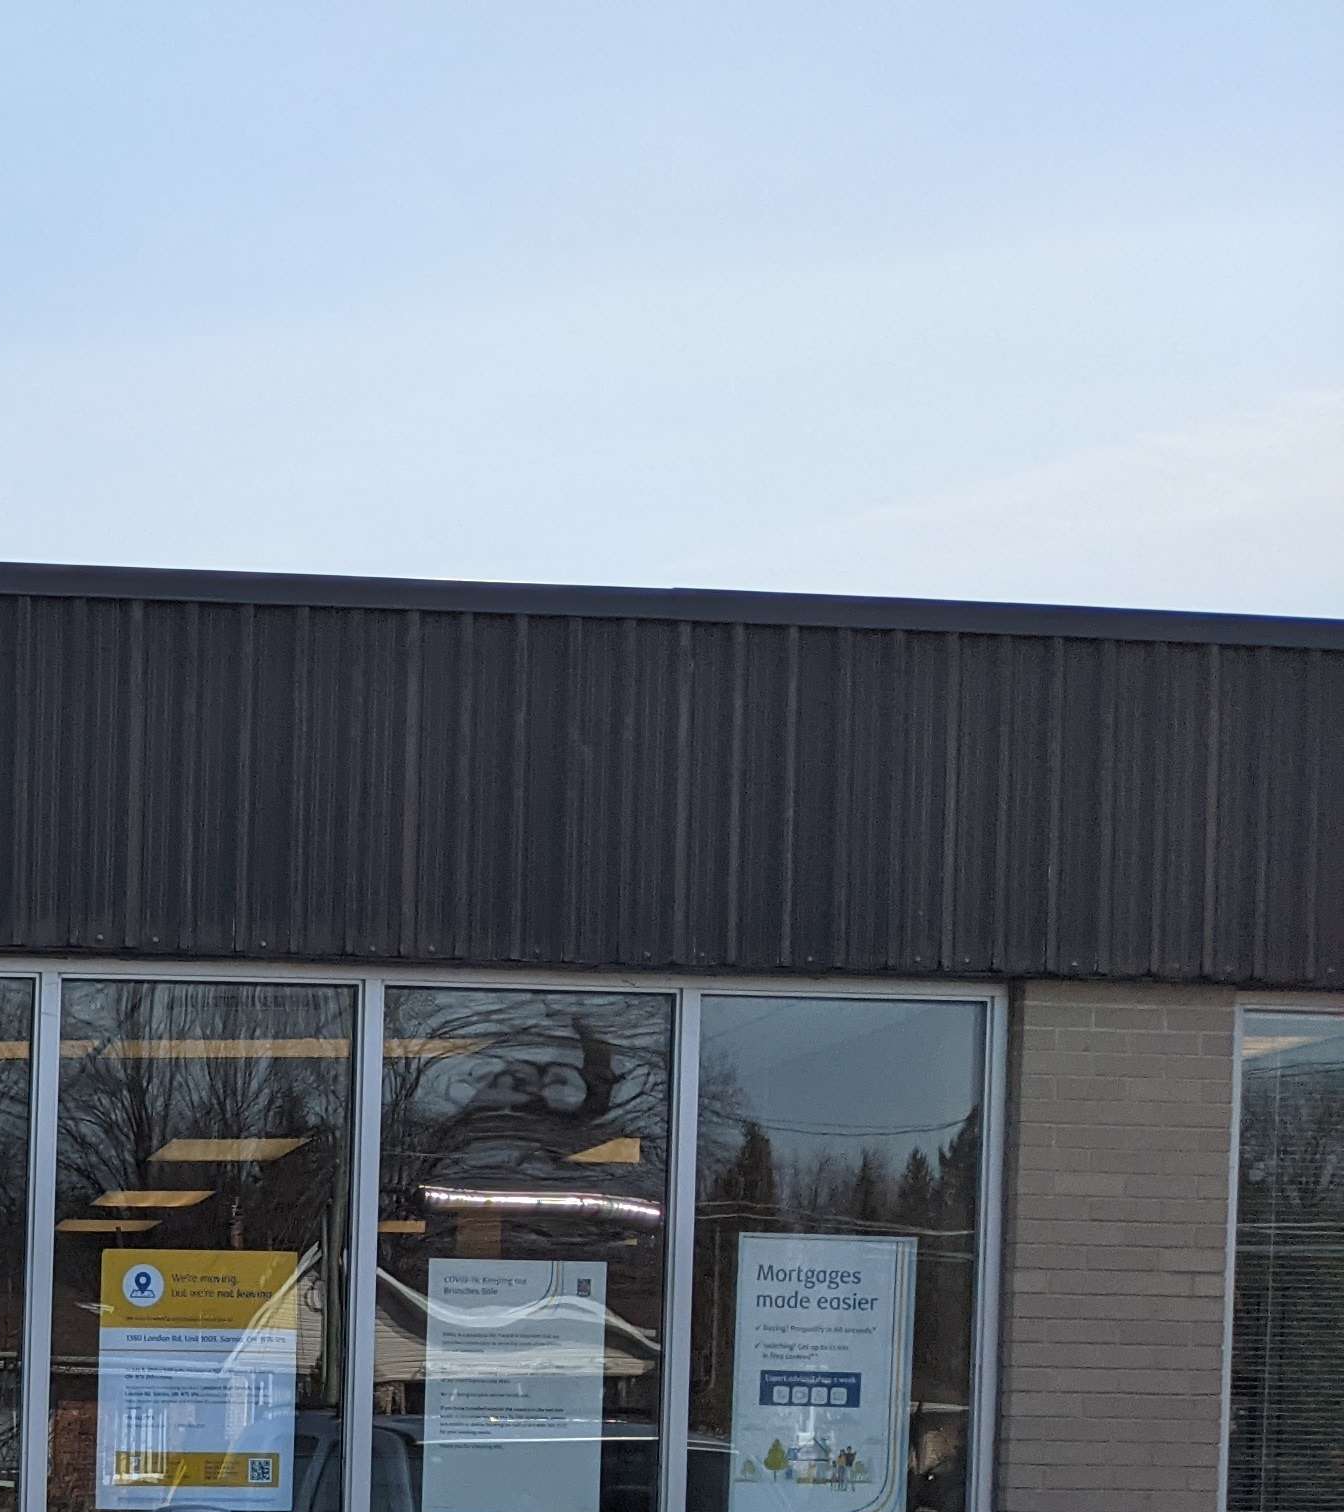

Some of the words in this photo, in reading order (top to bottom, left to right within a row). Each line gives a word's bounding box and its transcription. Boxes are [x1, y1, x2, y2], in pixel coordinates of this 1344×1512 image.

[756, 1263, 862, 1290] Mortgages
[756, 1290, 811, 1309] made
[816, 1292, 879, 1312] easier
